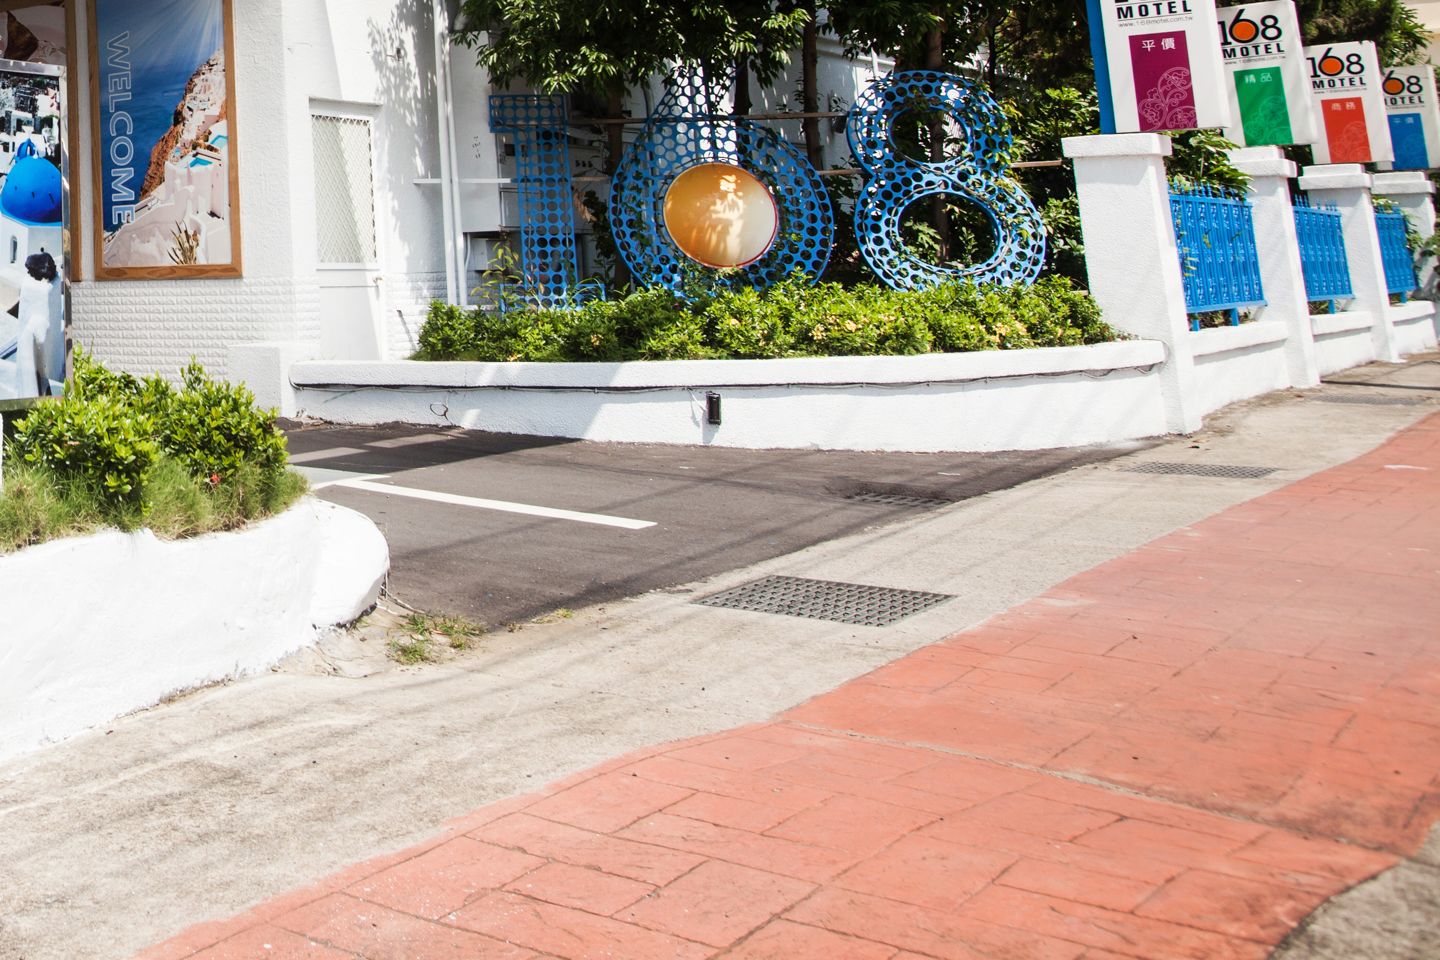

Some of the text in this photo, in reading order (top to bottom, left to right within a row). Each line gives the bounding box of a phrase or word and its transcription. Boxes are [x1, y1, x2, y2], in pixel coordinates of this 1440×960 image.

[1116, 0, 1192, 19] MOTEL
[1217, 9, 1282, 46] 168
[1141, 37, 1176, 52] 平價
[1222, 43, 1285, 59] MOTEL
[1306, 47, 1365, 78] 168
[1312, 77, 1366, 89] MOTEL
[1382, 70, 1423, 95] 68
[106, 30, 137, 226] WELCOME
